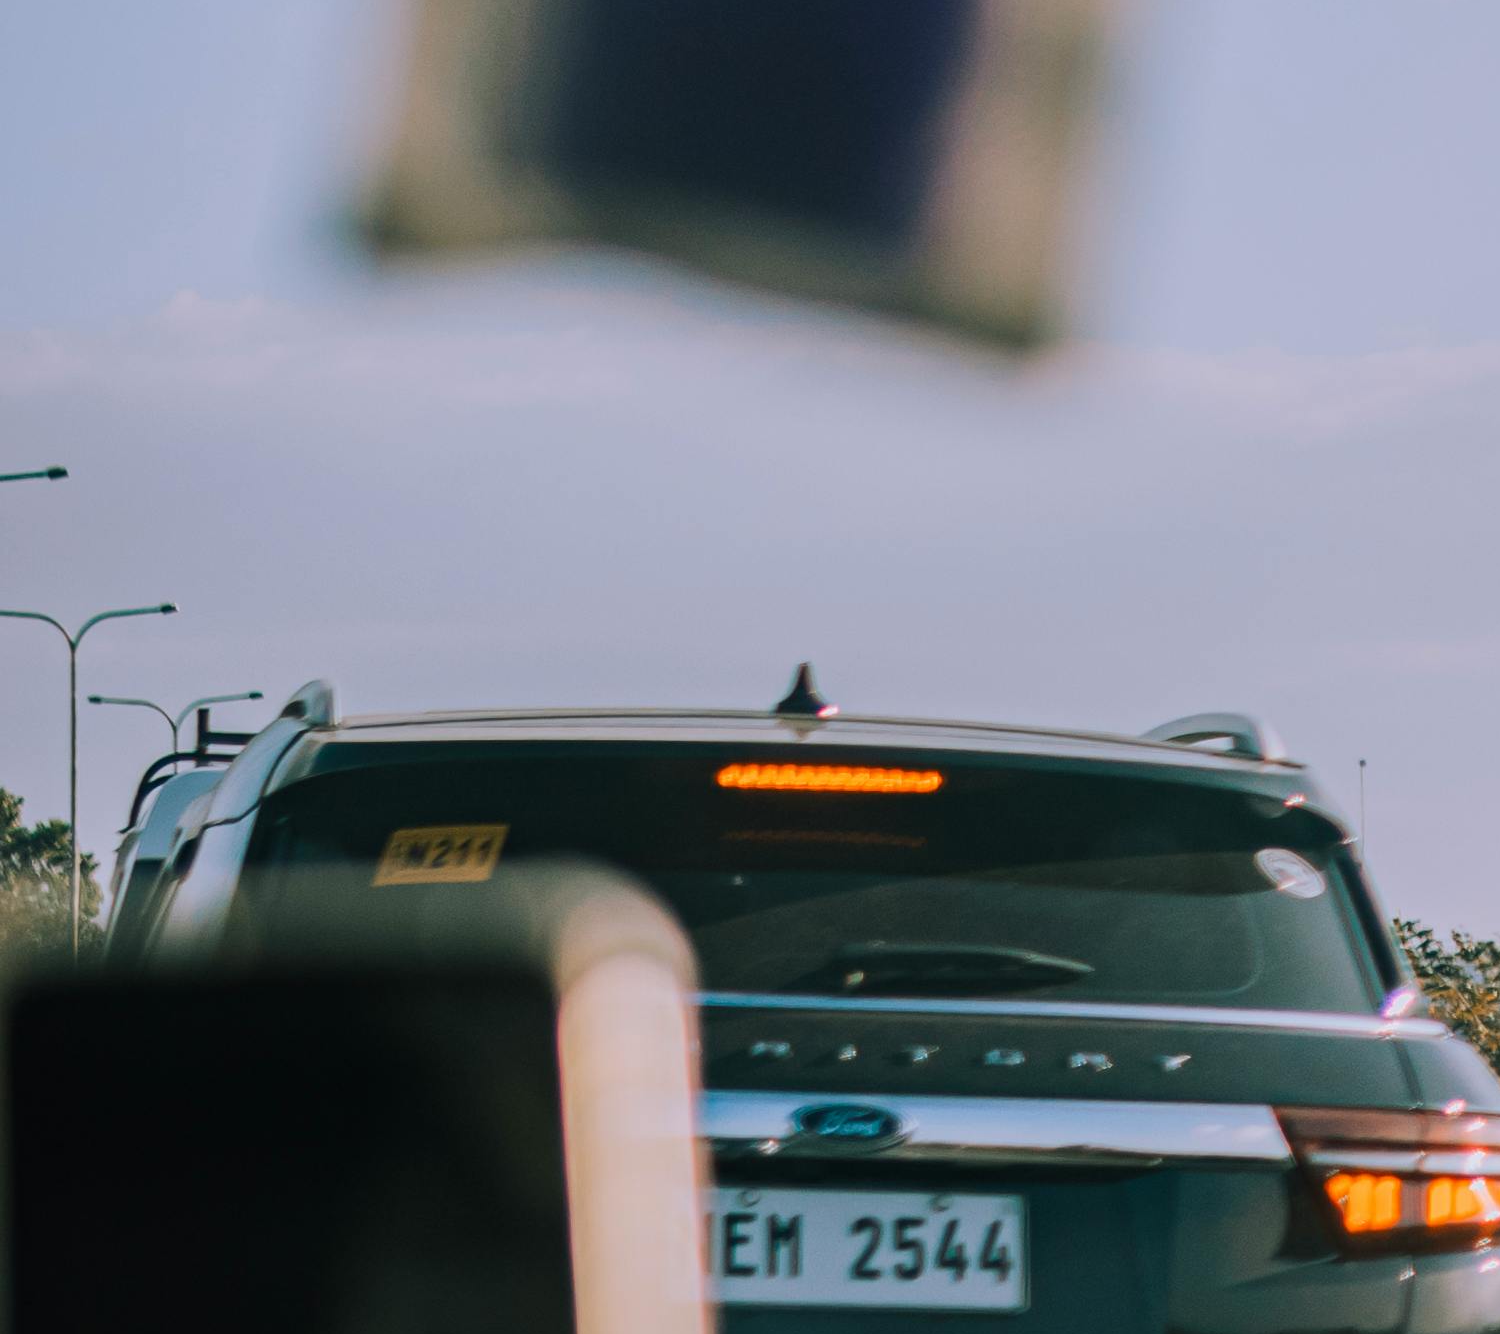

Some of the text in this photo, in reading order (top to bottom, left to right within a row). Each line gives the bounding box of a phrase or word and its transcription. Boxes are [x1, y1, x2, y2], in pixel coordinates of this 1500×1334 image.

[696, 1038, 1192, 1072] RITORY
[703, 1212, 1012, 1284] EM 2544
